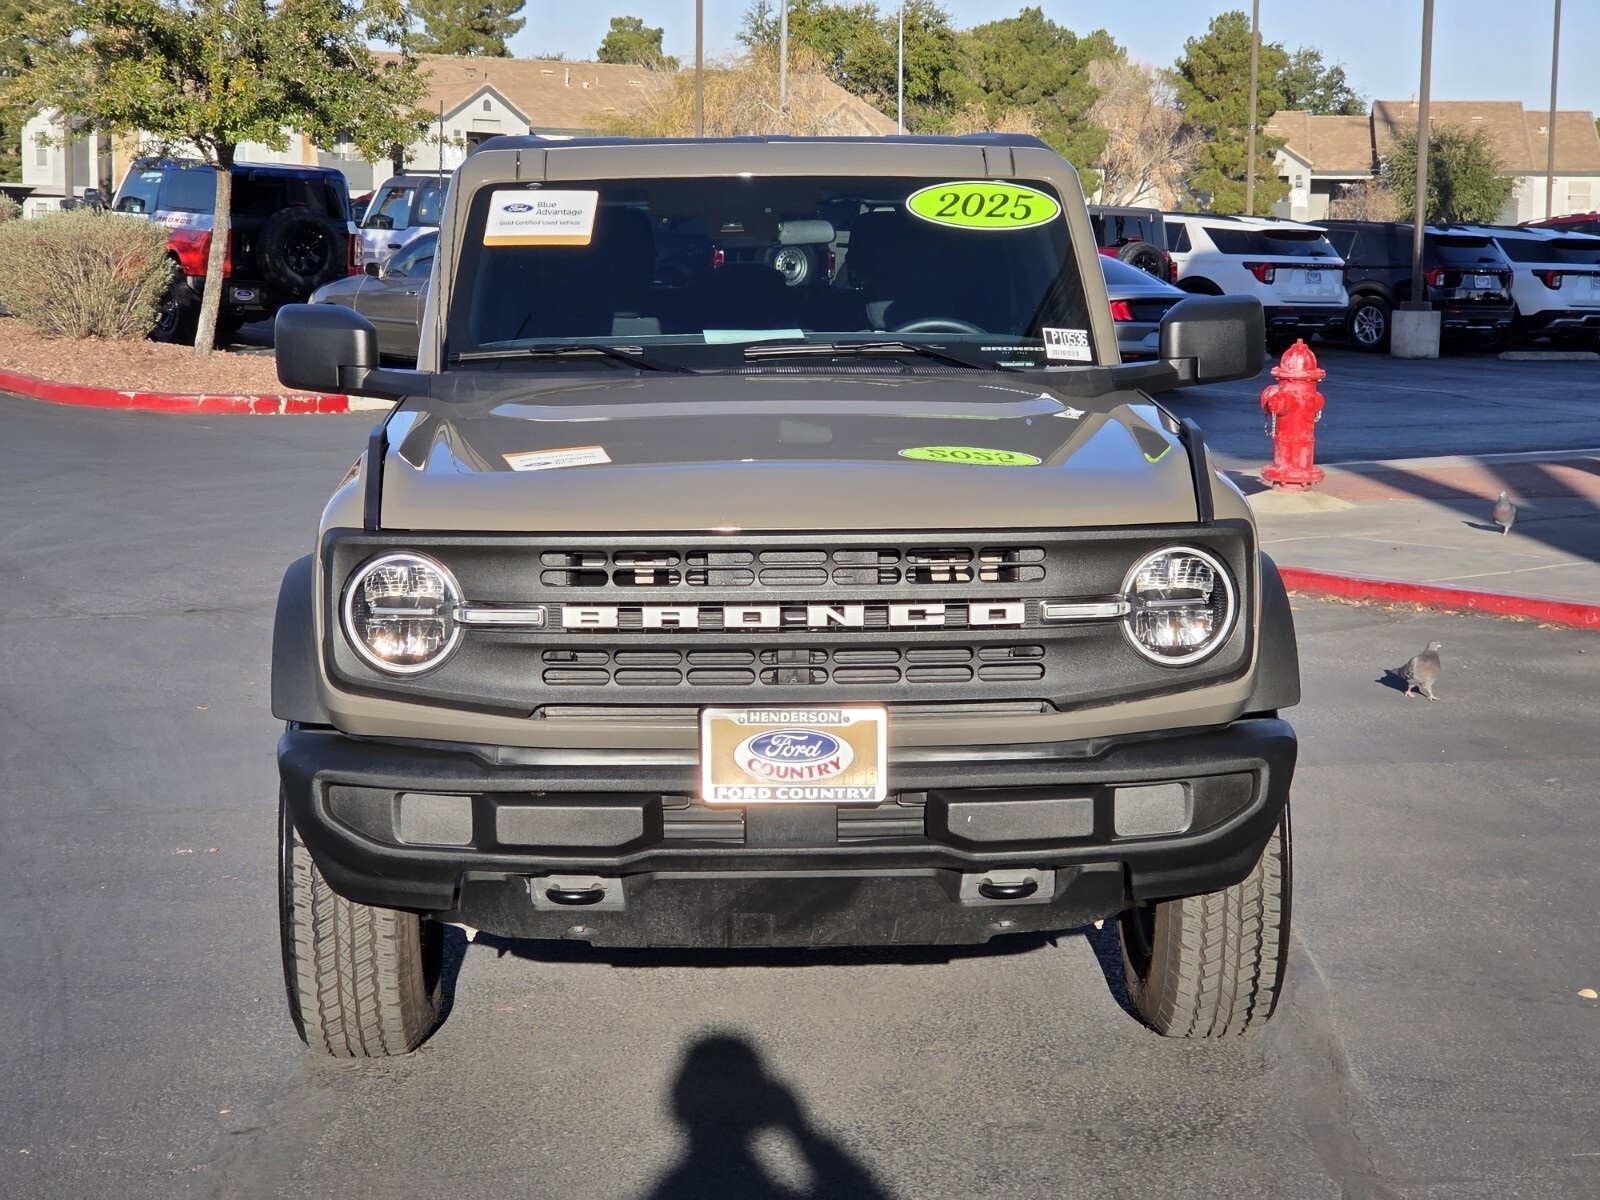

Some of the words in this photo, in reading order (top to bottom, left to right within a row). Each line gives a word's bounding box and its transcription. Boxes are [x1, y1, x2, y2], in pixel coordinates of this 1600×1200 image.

[535, 208, 583, 216] Advantage
[935, 192, 1034, 220] 2025
[561, 602, 1025, 628] BRONCO
[750, 711, 839, 723] HENDERSON
[765, 734, 823, 758] Ford
[747, 756, 842, 780] COUNTRY
[717, 787, 772, 800] FORD
[776, 787, 874, 800] COUNTRY
